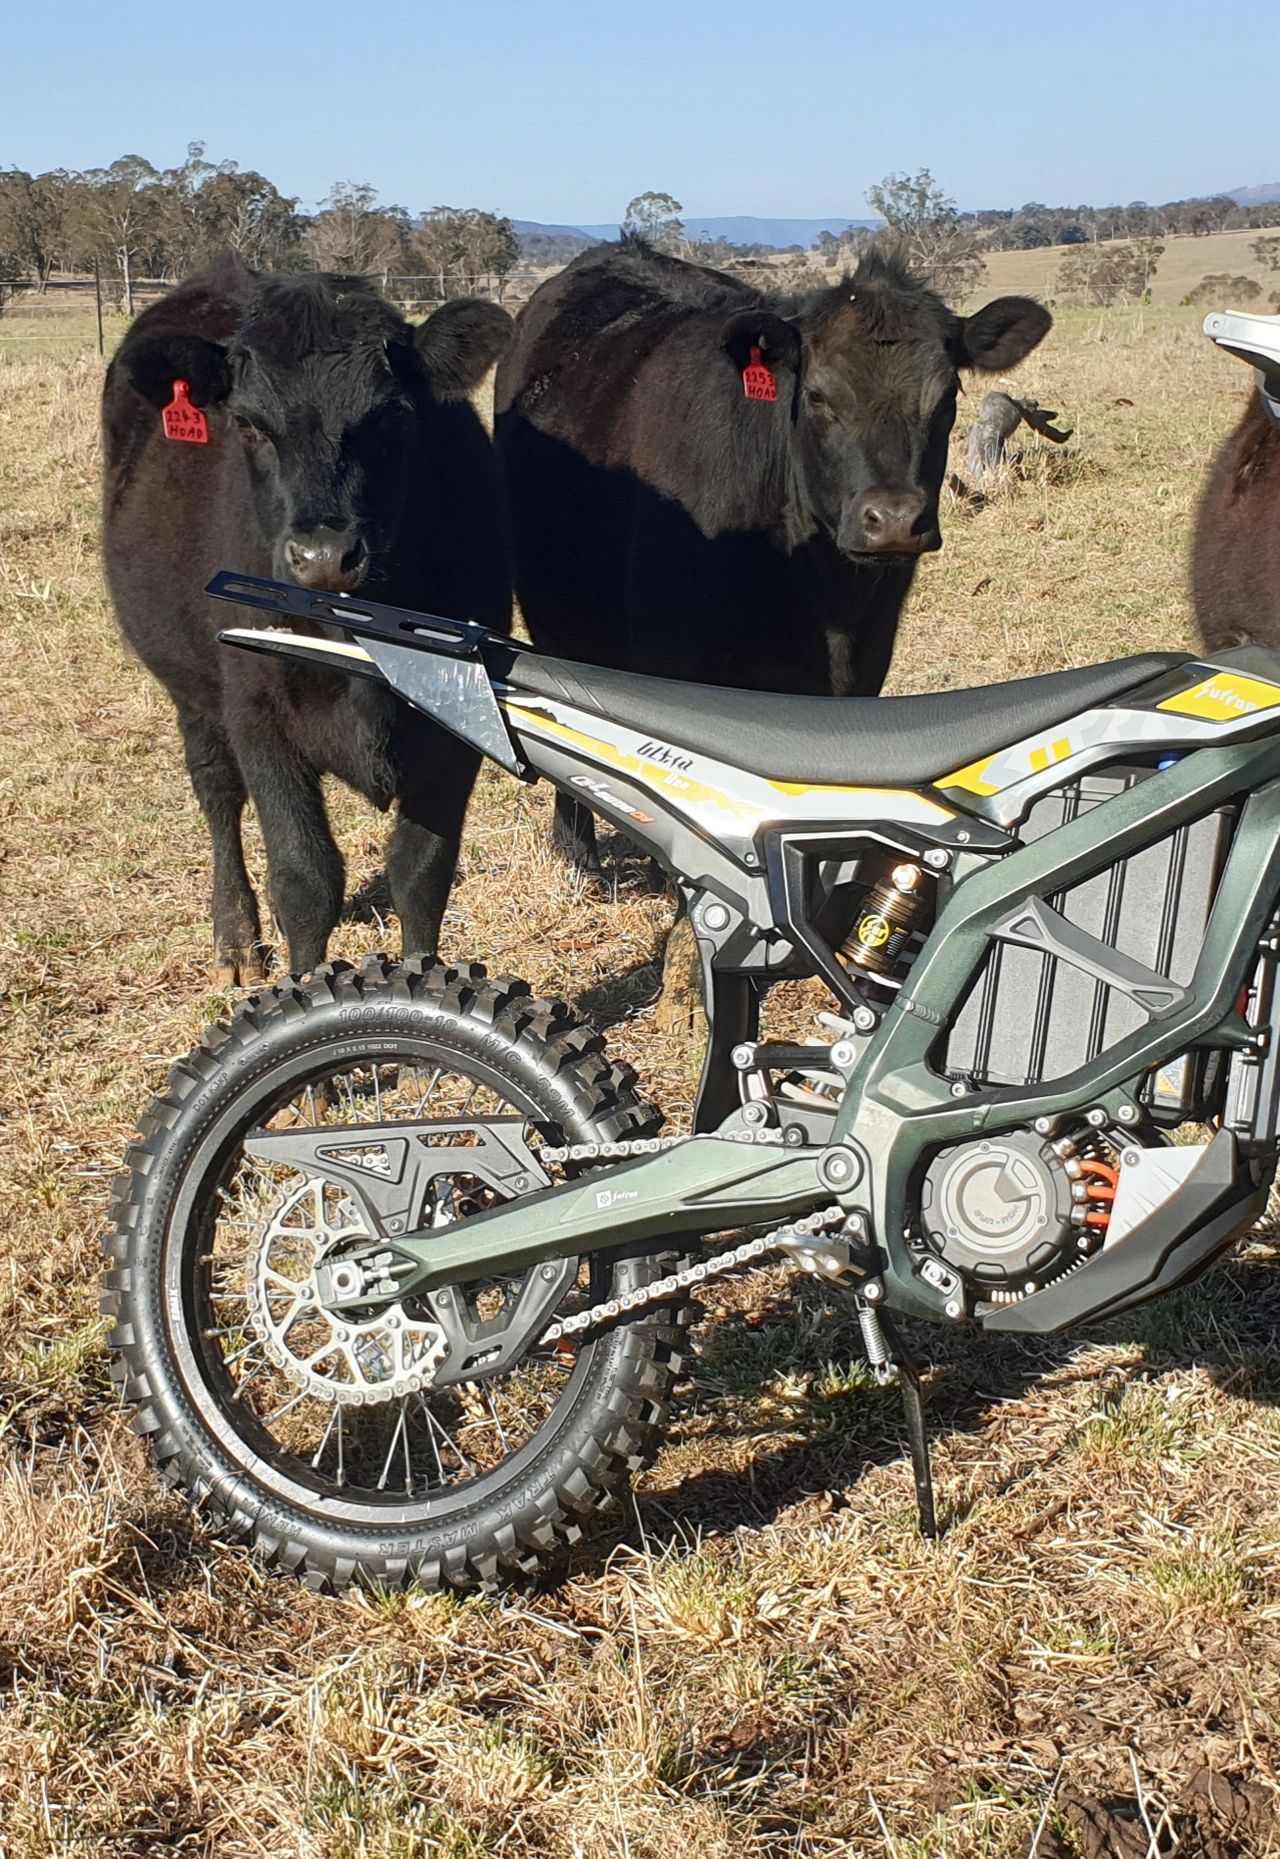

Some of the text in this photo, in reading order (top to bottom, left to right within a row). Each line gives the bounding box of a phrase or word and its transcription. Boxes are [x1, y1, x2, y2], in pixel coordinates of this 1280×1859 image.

[748, 386, 777, 398] HOAD
[169, 425, 203, 438] HOAD
[480, 1034, 522, 1064] M/C
[379, 1467, 558, 1556] TRAK MASTER
